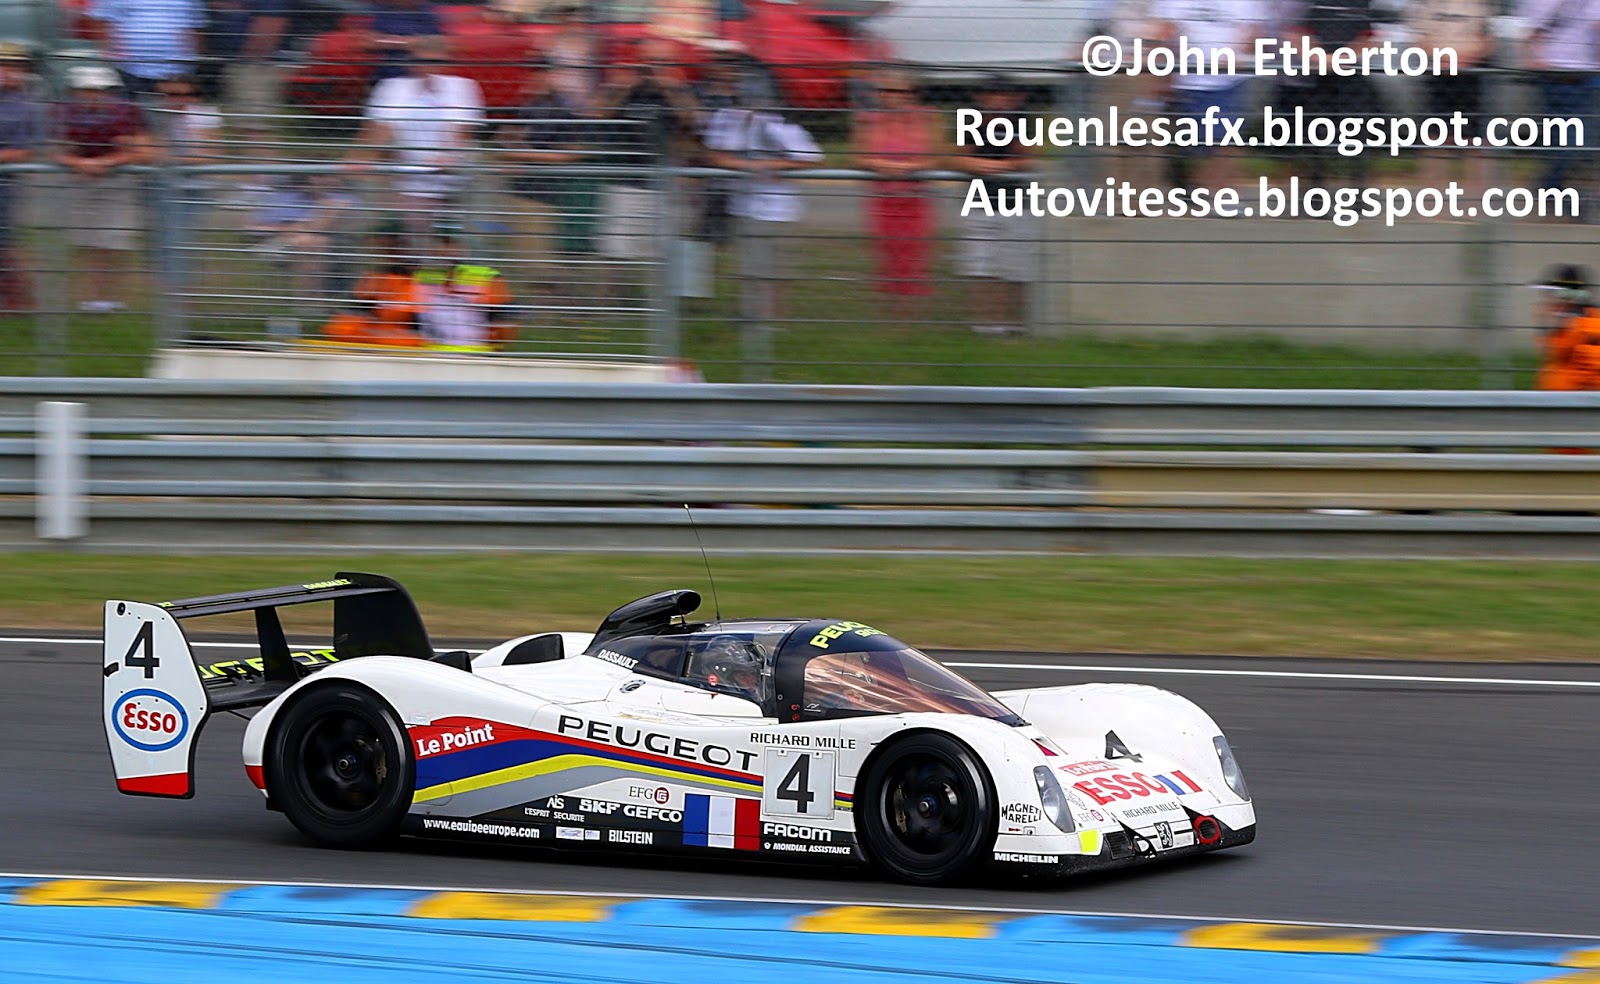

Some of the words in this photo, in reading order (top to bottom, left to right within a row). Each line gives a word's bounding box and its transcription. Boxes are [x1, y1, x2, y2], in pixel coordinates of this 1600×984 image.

[124, 621, 159, 678] 4
[597, 649, 639, 669] DASSAULT
[416, 739, 441, 756] Le
[441, 723, 494, 751] Point
[558, 714, 758, 771] PEUGEOT
[750, 733, 810, 747] RICHARD
[815, 737, 856, 749] MILLE
[1105, 730, 1143, 763] 4
[629, 786, 653, 799] EFG
[776, 753, 815, 814] 4
[553, 811, 585, 822] SECURITE
[579, 799, 620, 815] SKF
[623, 805, 683, 823] GEFCO
[1122, 805, 1158, 818] RICHARD
[1155, 801, 1181, 812] MILLE
[608, 829, 653, 845] BILSTEIN
[763, 823, 832, 842] FACOM
[773, 842, 808, 852] MONDIAL
[808, 845, 851, 855] ASSISTANCE
[994, 852, 1059, 864] MICHELIN
